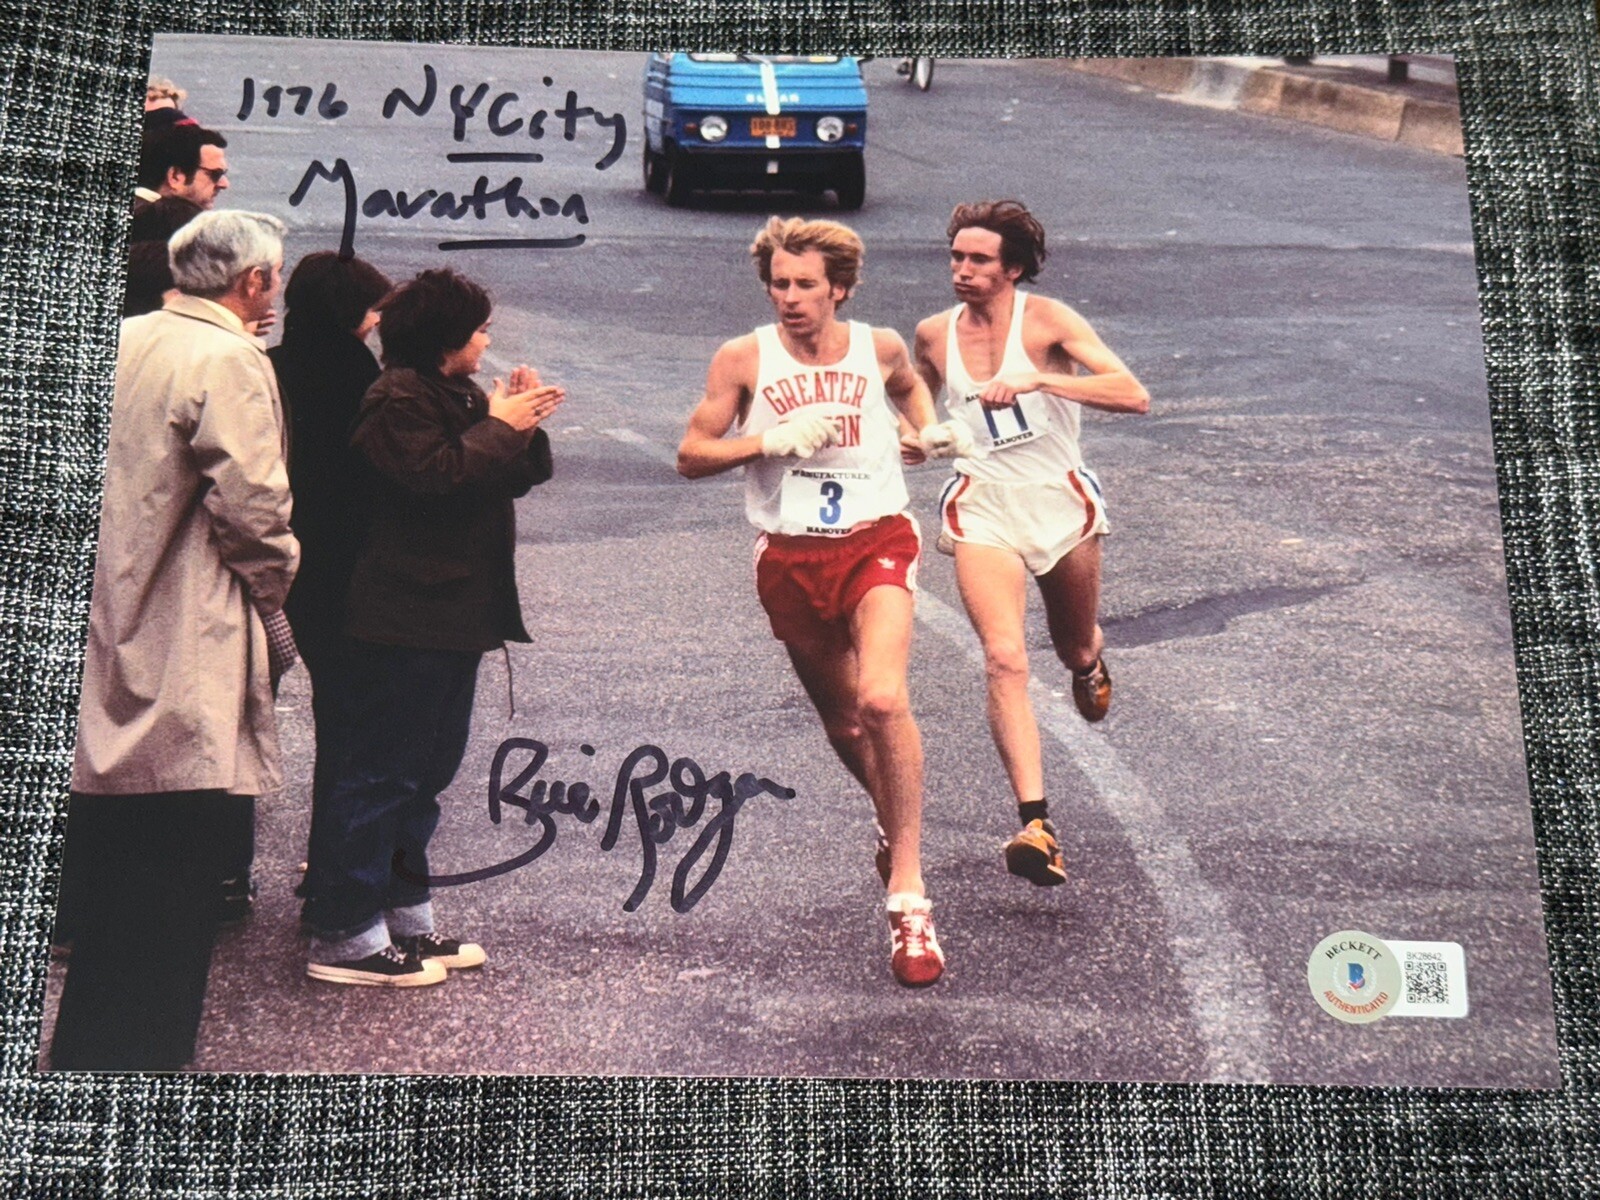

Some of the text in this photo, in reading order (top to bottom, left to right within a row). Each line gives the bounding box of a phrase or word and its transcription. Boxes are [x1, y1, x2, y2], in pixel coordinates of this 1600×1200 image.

[237, 77, 348, 121] 1976
[289, 158, 589, 259] Marathon
[762, 371, 868, 416] GREATER
[993, 431, 1034, 447] HANOVER
[819, 481, 843, 525] 3
[1325, 941, 1382, 960] BECKETT
[1406, 952, 1442, 961] BK28642
[1323, 990, 1389, 1015] AUTHENTICATED
